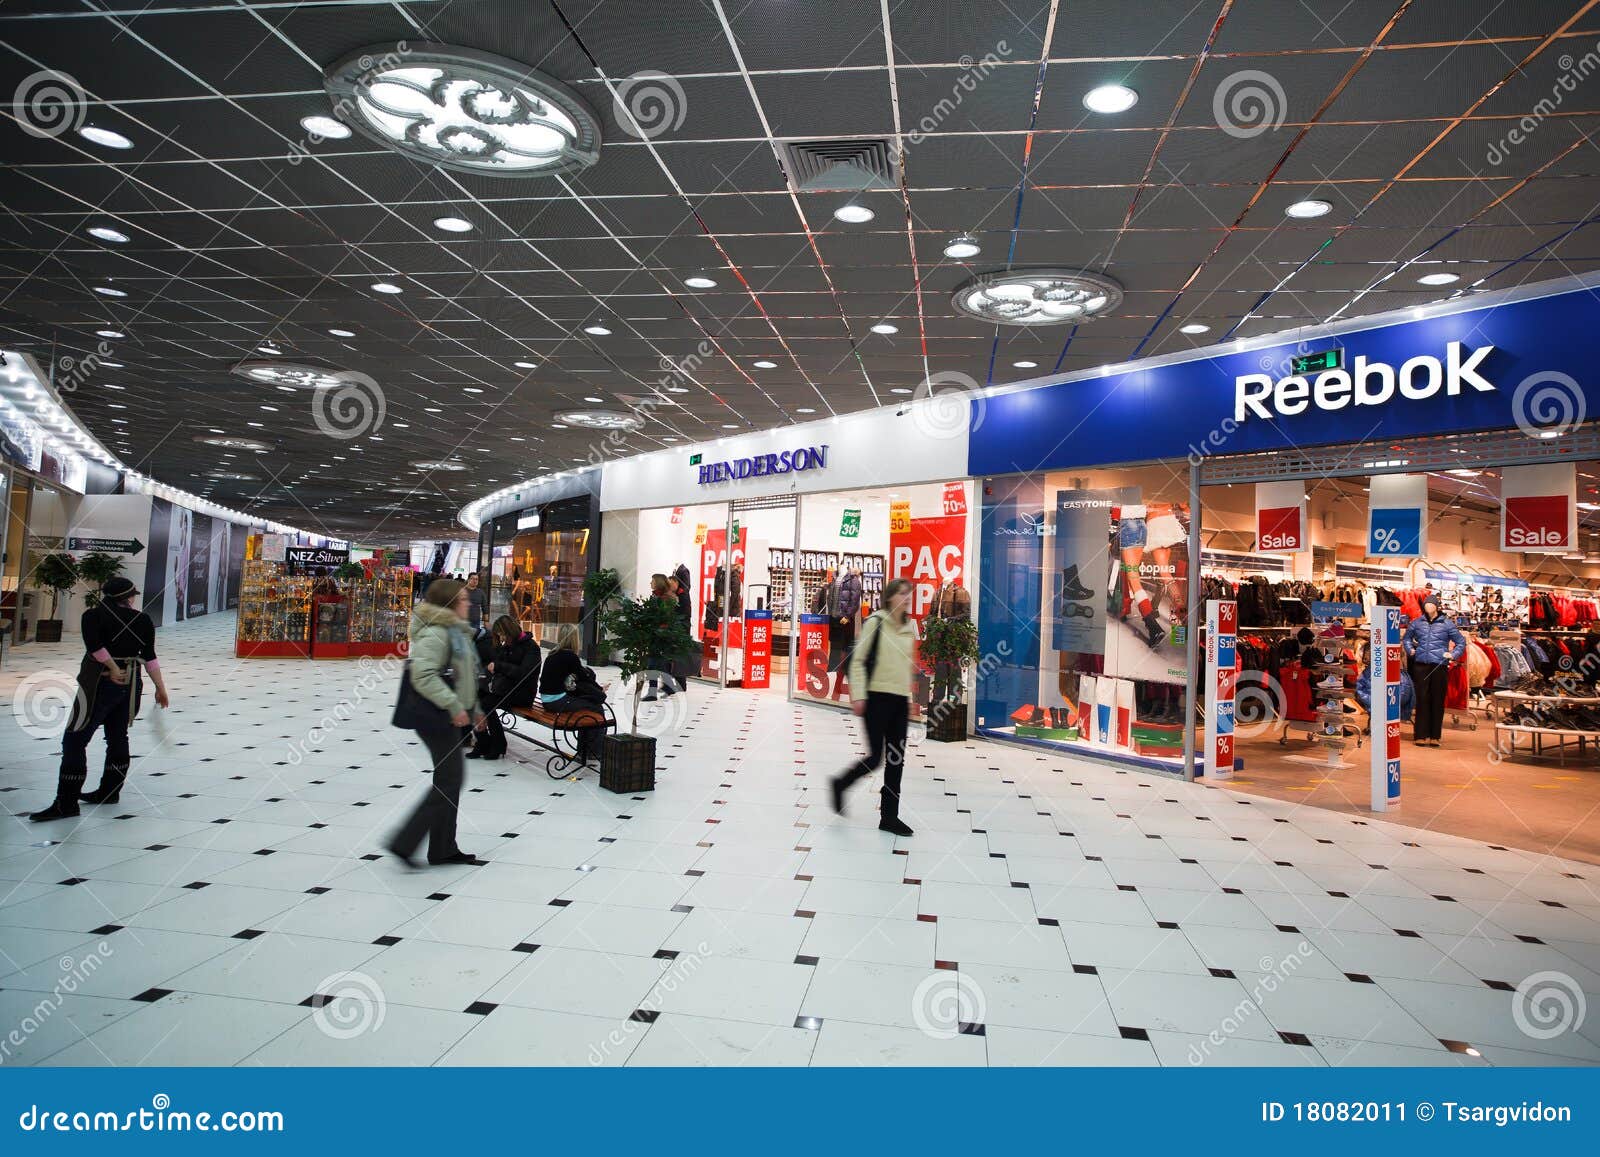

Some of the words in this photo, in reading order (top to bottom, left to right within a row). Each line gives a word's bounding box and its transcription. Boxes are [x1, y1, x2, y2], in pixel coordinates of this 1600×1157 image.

[1235, 341, 1496, 422] Reebok
[698, 445, 829, 484] HENDERSON
[1063, 500, 1113, 509] EASYTONE
[1262, 533, 1296, 549] Sale
[1374, 528, 1400, 552] %
[1509, 527, 1561, 545] Sale
[289, 551, 314, 562] NEZ
[315, 551, 347, 563] Silver
[894, 545, 962, 582] РАС
[1220, 604, 1233, 621] %
[1218, 671, 1229, 687] %
[1388, 687, 1396, 705] %
[1218, 704, 1233, 715] Sale
[1218, 738, 1229, 754] %
[1388, 763, 1399, 782] %
